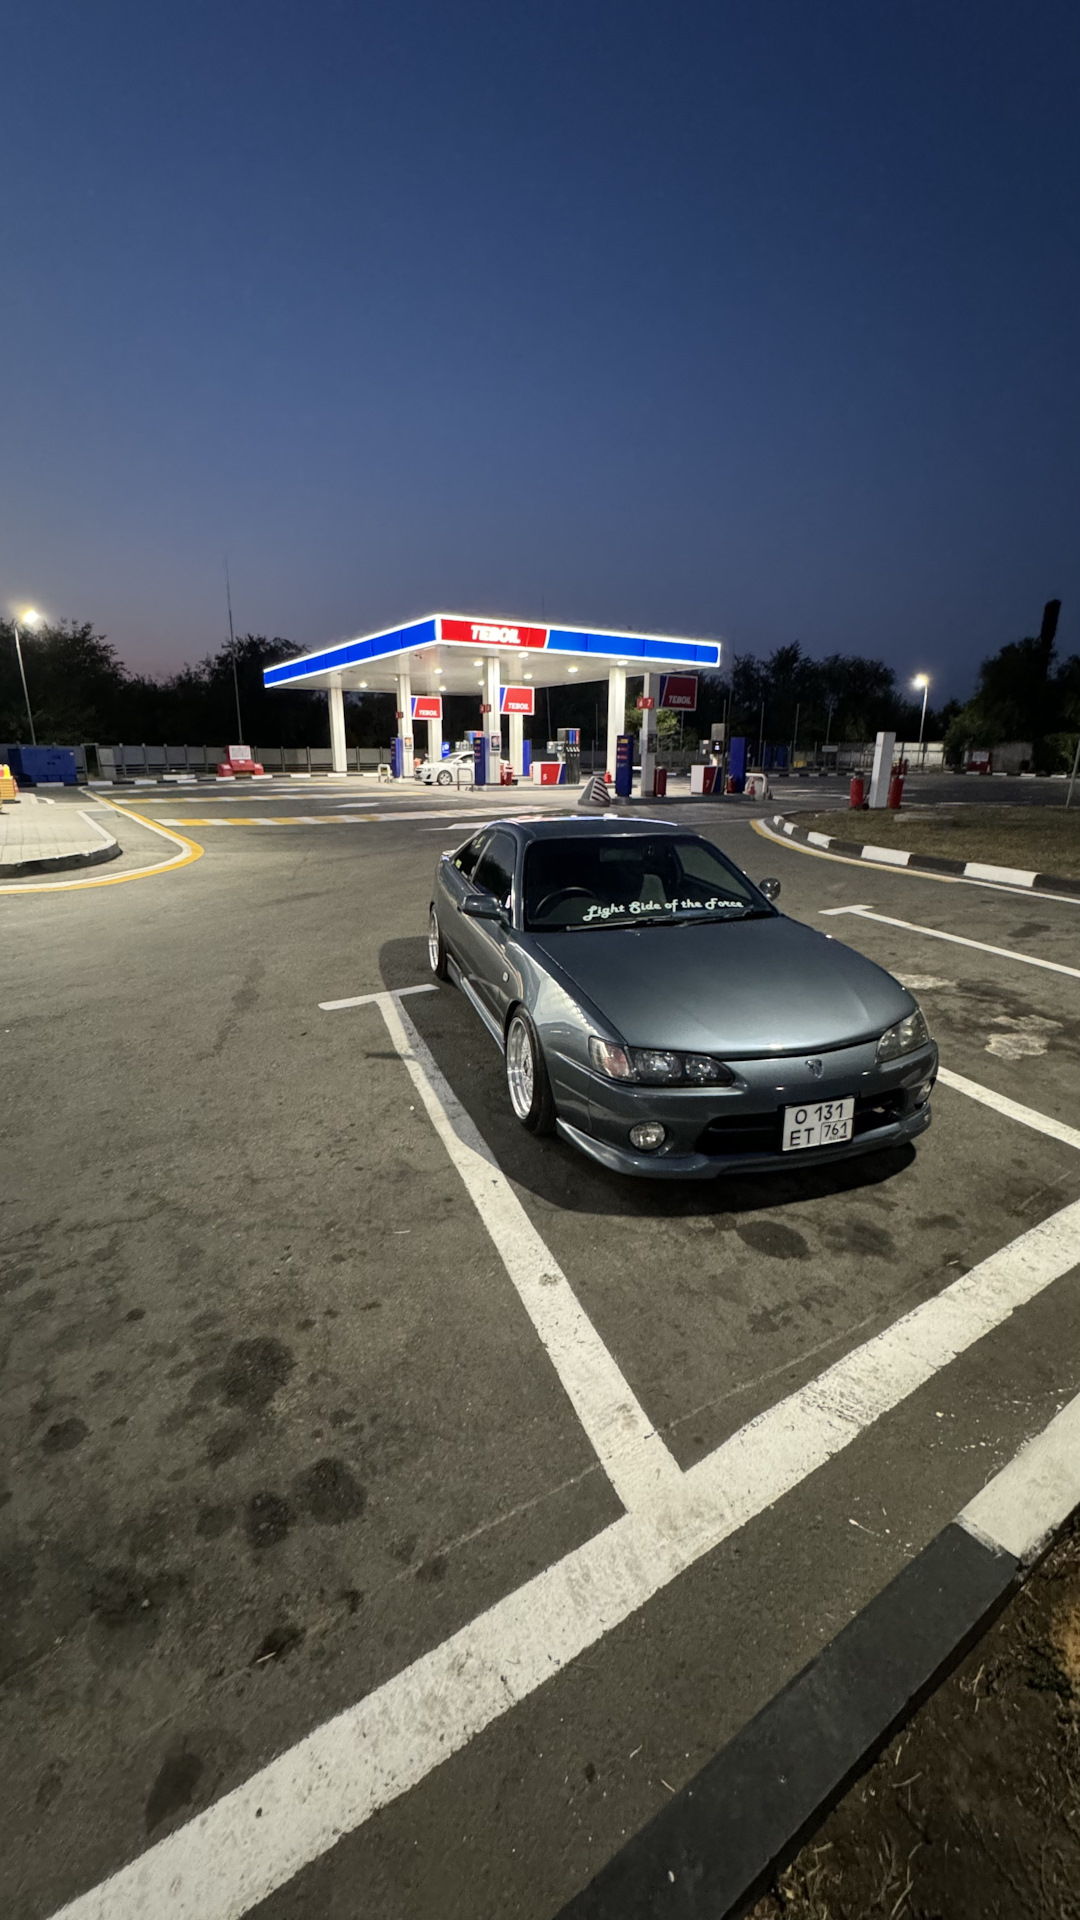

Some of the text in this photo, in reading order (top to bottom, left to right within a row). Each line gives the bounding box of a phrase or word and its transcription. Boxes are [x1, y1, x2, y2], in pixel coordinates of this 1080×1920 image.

[471, 625, 521, 644] TEBOIL
[508, 702, 529, 711] TEBOIL
[669, 695, 691, 704] TEBOIL
[418, 709, 438, 717] TEBOIL
[583, 898, 744, 921] Light Side of the Force
[814, 1103, 843, 1121] 131
[790, 1127, 814, 1146] ET
[824, 1122, 847, 1137] 761
